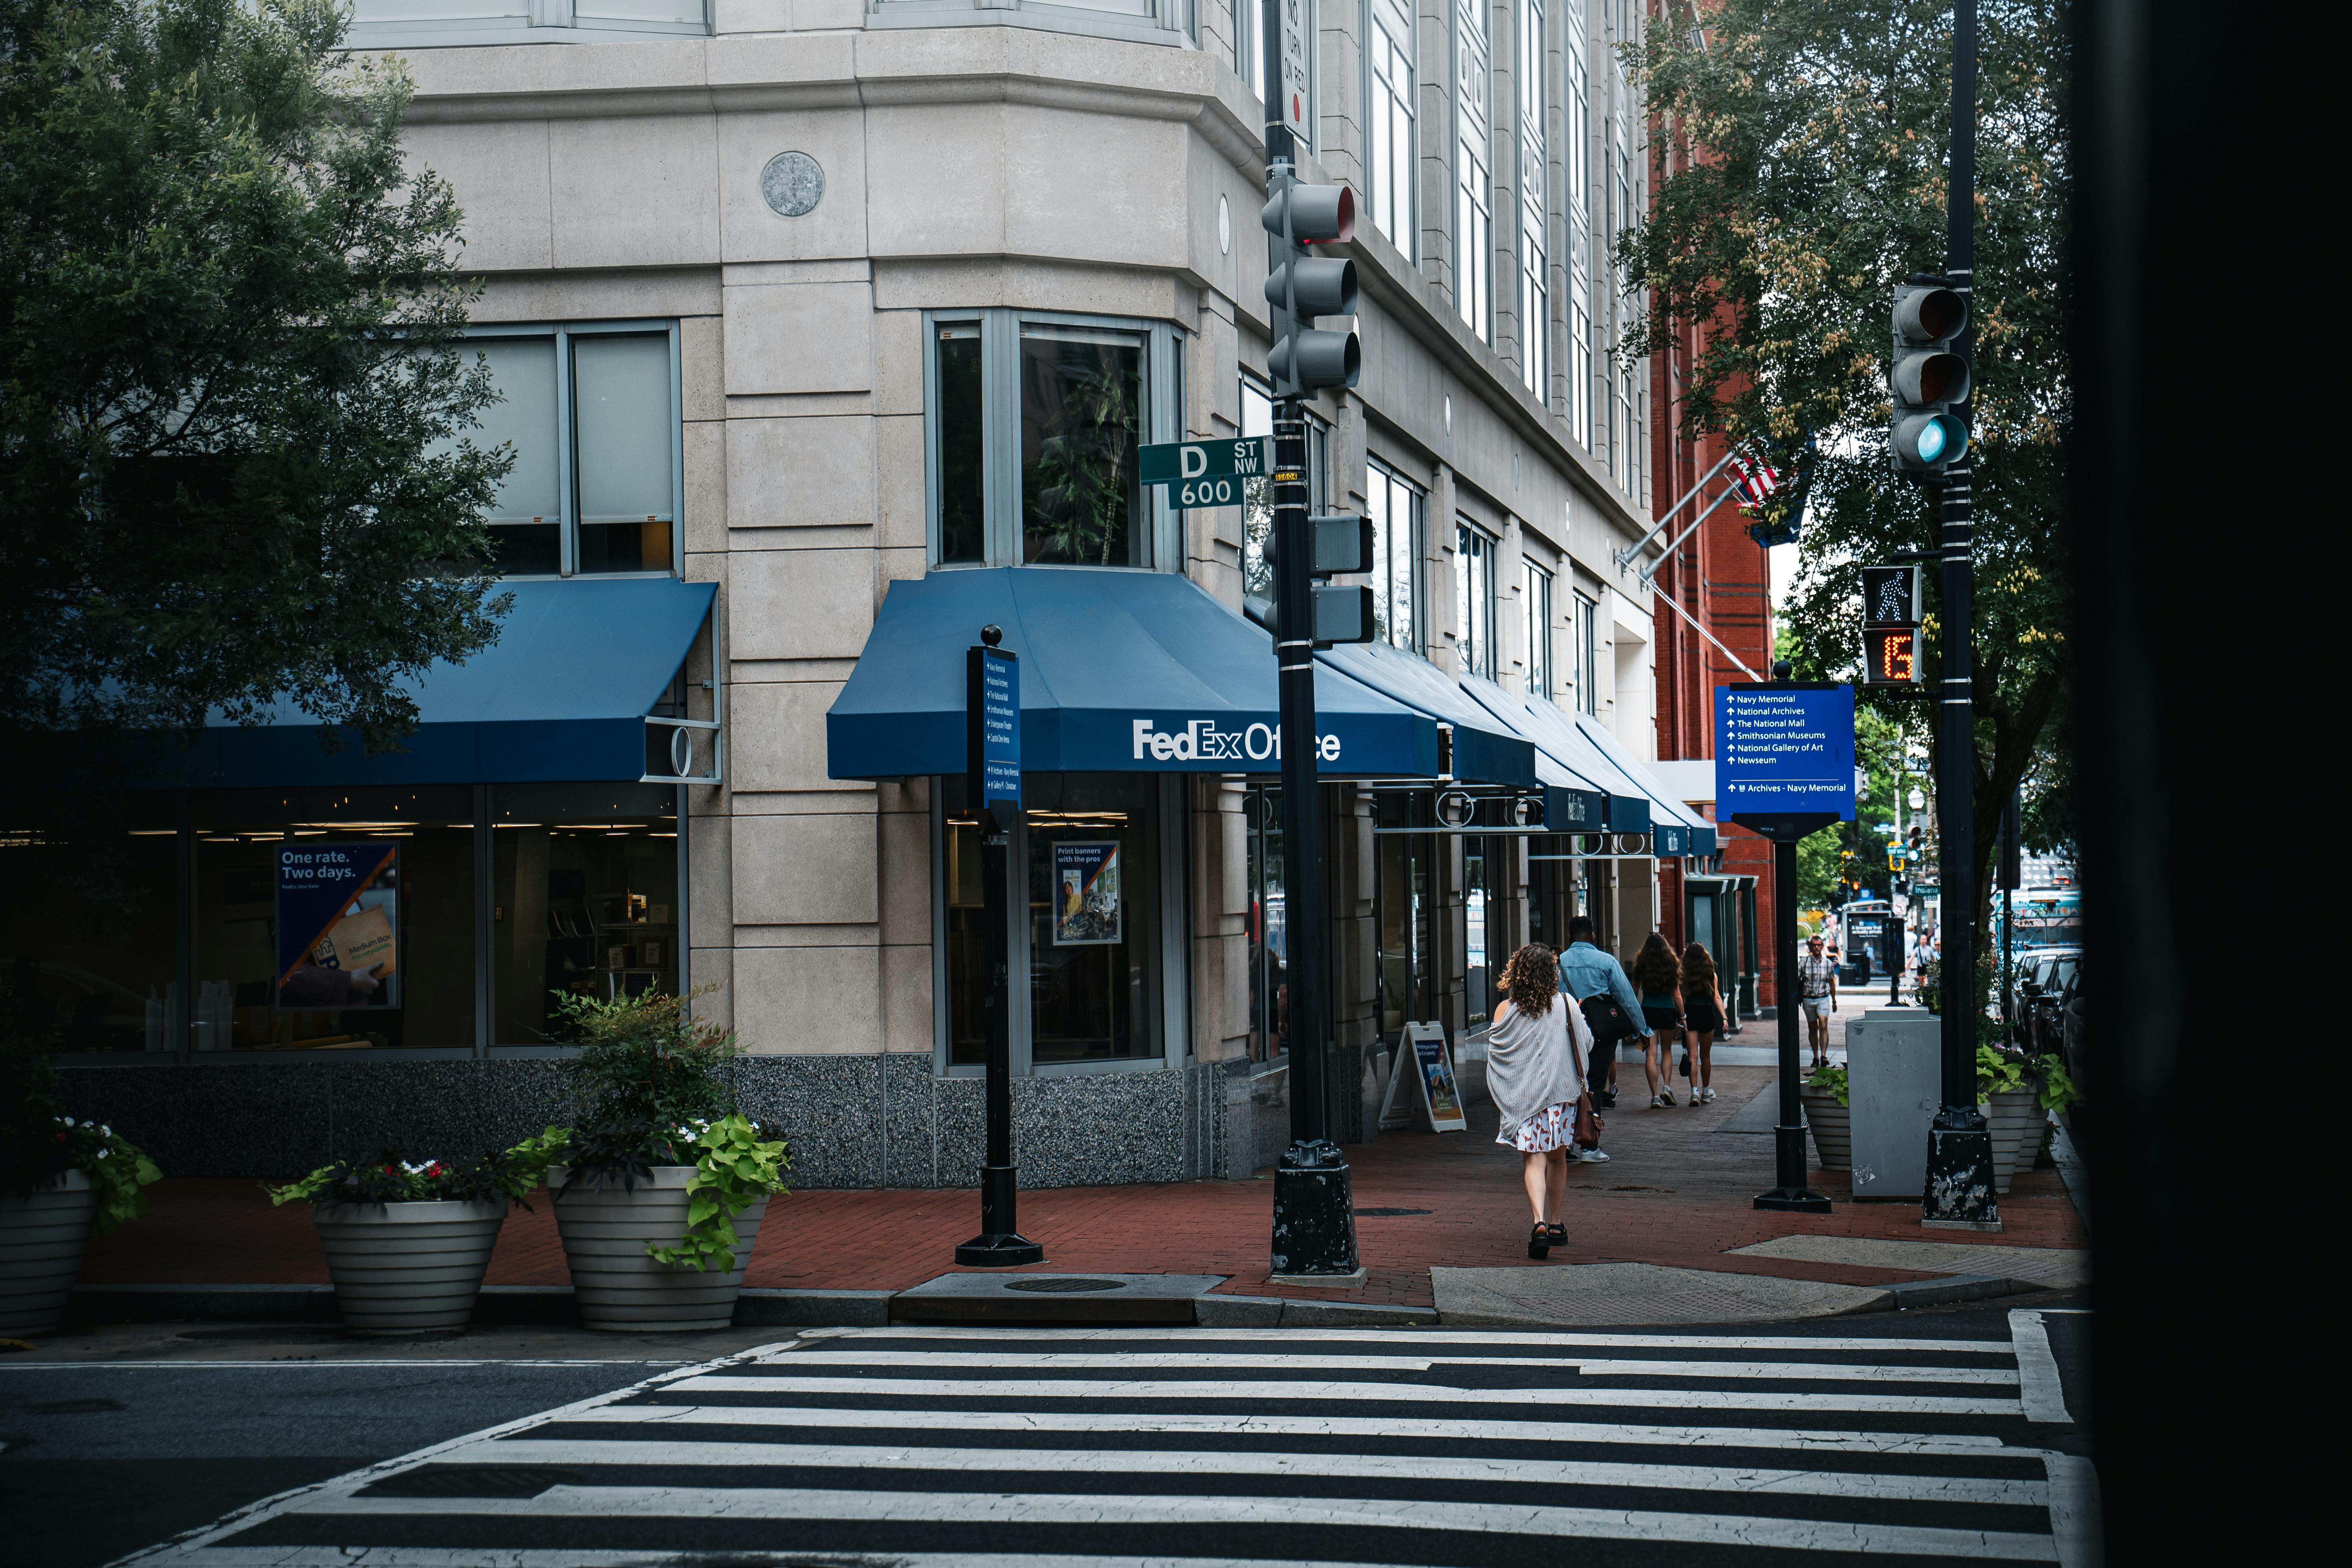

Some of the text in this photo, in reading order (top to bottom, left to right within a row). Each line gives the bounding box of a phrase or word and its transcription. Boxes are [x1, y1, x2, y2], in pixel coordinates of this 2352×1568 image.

[1288, 0, 1298, 27] NO
[1287, 28, 1301, 61] TURN
[1285, 57, 1305, 93] ON RED
[1180, 441, 1257, 478] D ST
[1235, 458, 1257, 474] NW
[1181, 480, 1231, 505] 600
[1884, 635, 1913, 679] 15
[995, 664, 1005, 673] Memorial
[990, 677, 1008, 688] National Archives
[994, 692, 1003, 700] National
[1737, 696, 1756, 704] Navy
[990, 705, 1014, 716] Smithsonian Museums
[990, 720, 1004, 730] Shakespeare
[1133, 719, 1340, 761] FedEx Ofe
[1772, 744, 1800, 753] Gallery
[993, 767, 1003, 775] Archives
[1009, 768, 1019, 776] Memorial
[1005, 781, 1016, 790] Chinatown
[1787, 785, 1807, 793] Navy
[282, 851, 350, 864] One rate.
[282, 866, 356, 881] Two days.
[349, 934, 391, 954] Medium Box
